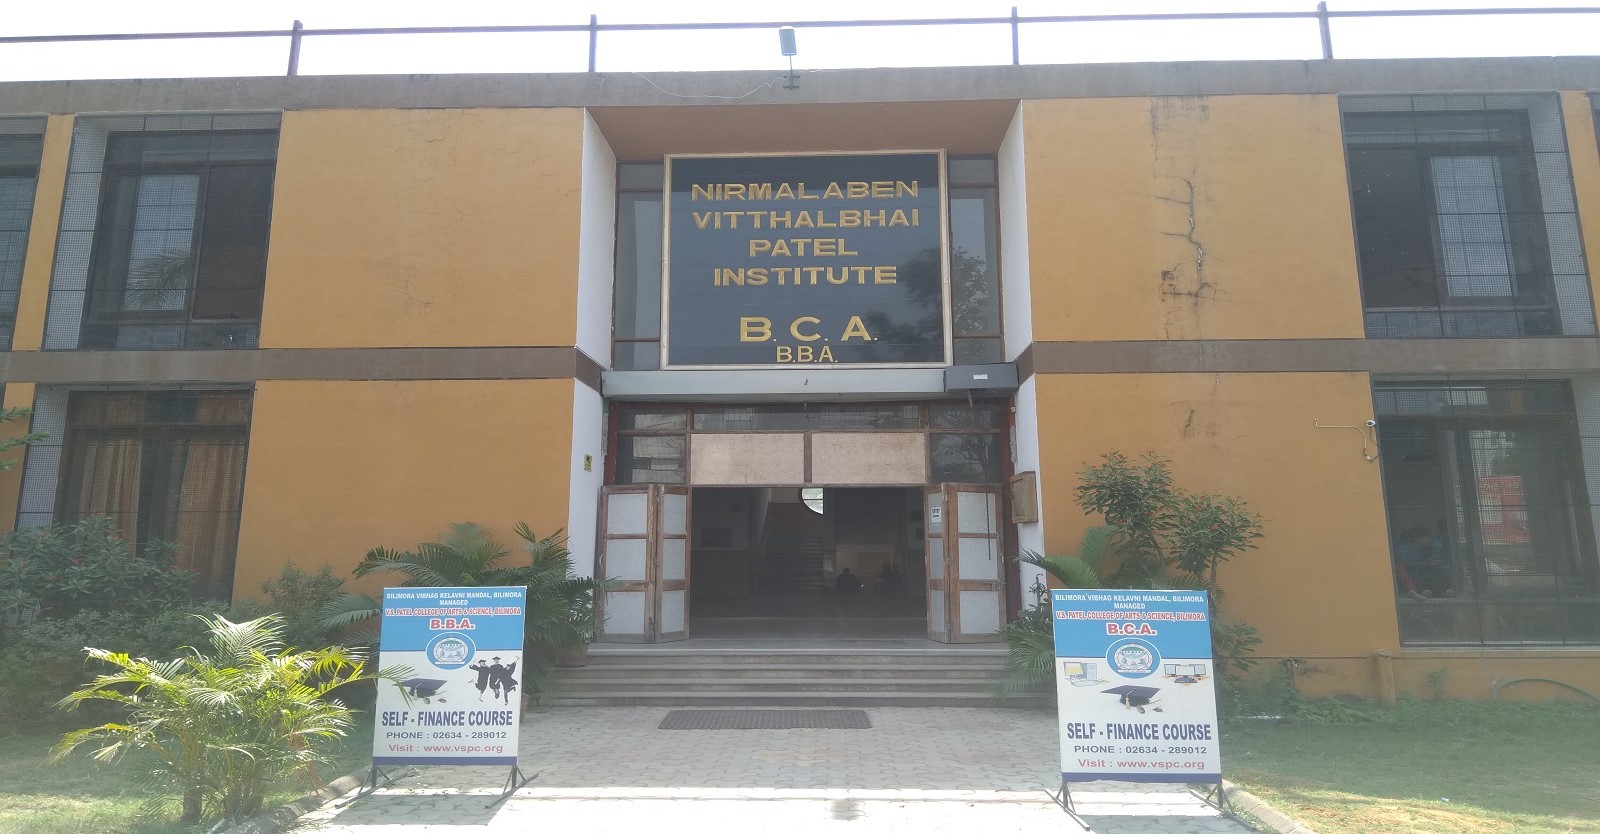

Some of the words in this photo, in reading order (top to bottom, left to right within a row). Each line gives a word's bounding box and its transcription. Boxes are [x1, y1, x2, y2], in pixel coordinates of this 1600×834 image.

[691, 180, 919, 201] NIRMALABEN
[692, 209, 919, 229] VITTHALBHAI
[749, 238, 859, 257] PATEL
[714, 266, 897, 286] INSTITUTE
[776, 346, 838, 363] B.B.A.
[396, 608, 412, 616] PATEL
[469, 607, 493, 617] SCIENCE,
[495, 607, 521, 615] BILIMORA
[1068, 611, 1086, 619] PATEL
[1125, 612, 1140, 620] ARTS
[1142, 612, 1147, 620] &
[1148, 612, 1175, 622] SCIENCE,
[1176, 613, 1205, 621] BILIMORA
[430, 619, 475, 630] B.B.A.
[1107, 623, 1157, 635] B.C.A.
[382, 712, 408, 726] SELF
[418, 711, 465, 726] FINANCE
[469, 711, 513, 725] COURSE
[1067, 723, 1095, 739] SELF
[1107, 723, 1159, 740] FINANCE
[1163, 724, 1211, 740] COURSE
[424, 745, 503, 753] www.vspc.org
[1078, 759, 1105, 767] Visit
[1117, 761, 1204, 770] www.vspc.org
